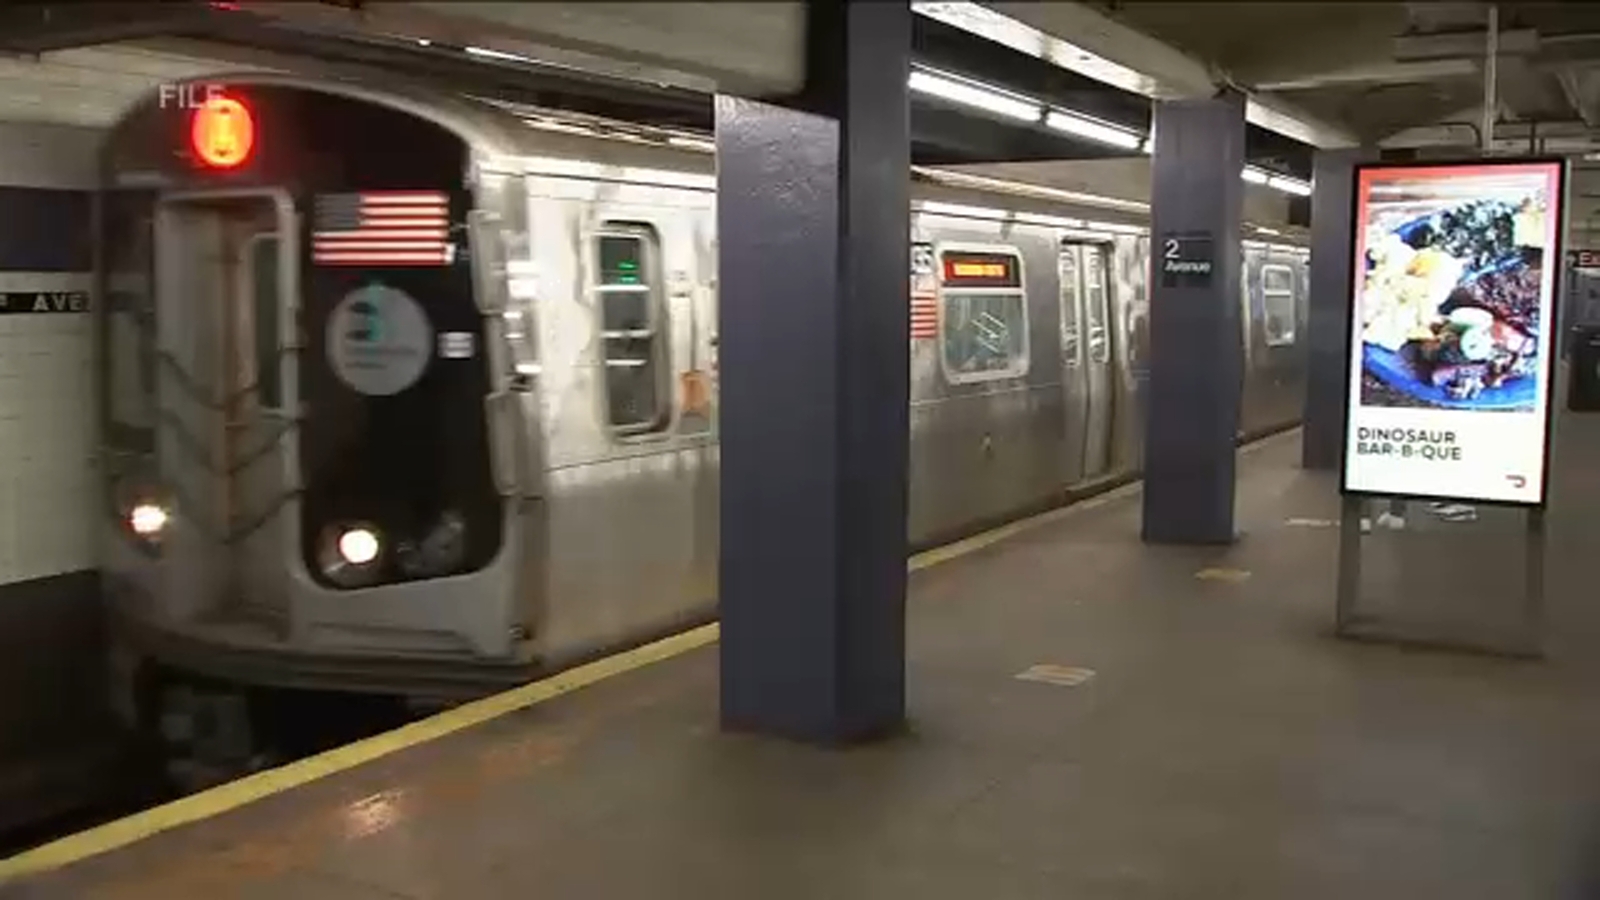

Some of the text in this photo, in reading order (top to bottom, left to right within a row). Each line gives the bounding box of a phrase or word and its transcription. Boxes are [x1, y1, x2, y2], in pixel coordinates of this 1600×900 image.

[1165, 239, 1180, 258] 2
[1164, 259, 1211, 273] Avenue
[1357, 427, 1457, 444] DINOSAUR
[1357, 442, 1462, 461] BAR-B-QUE
